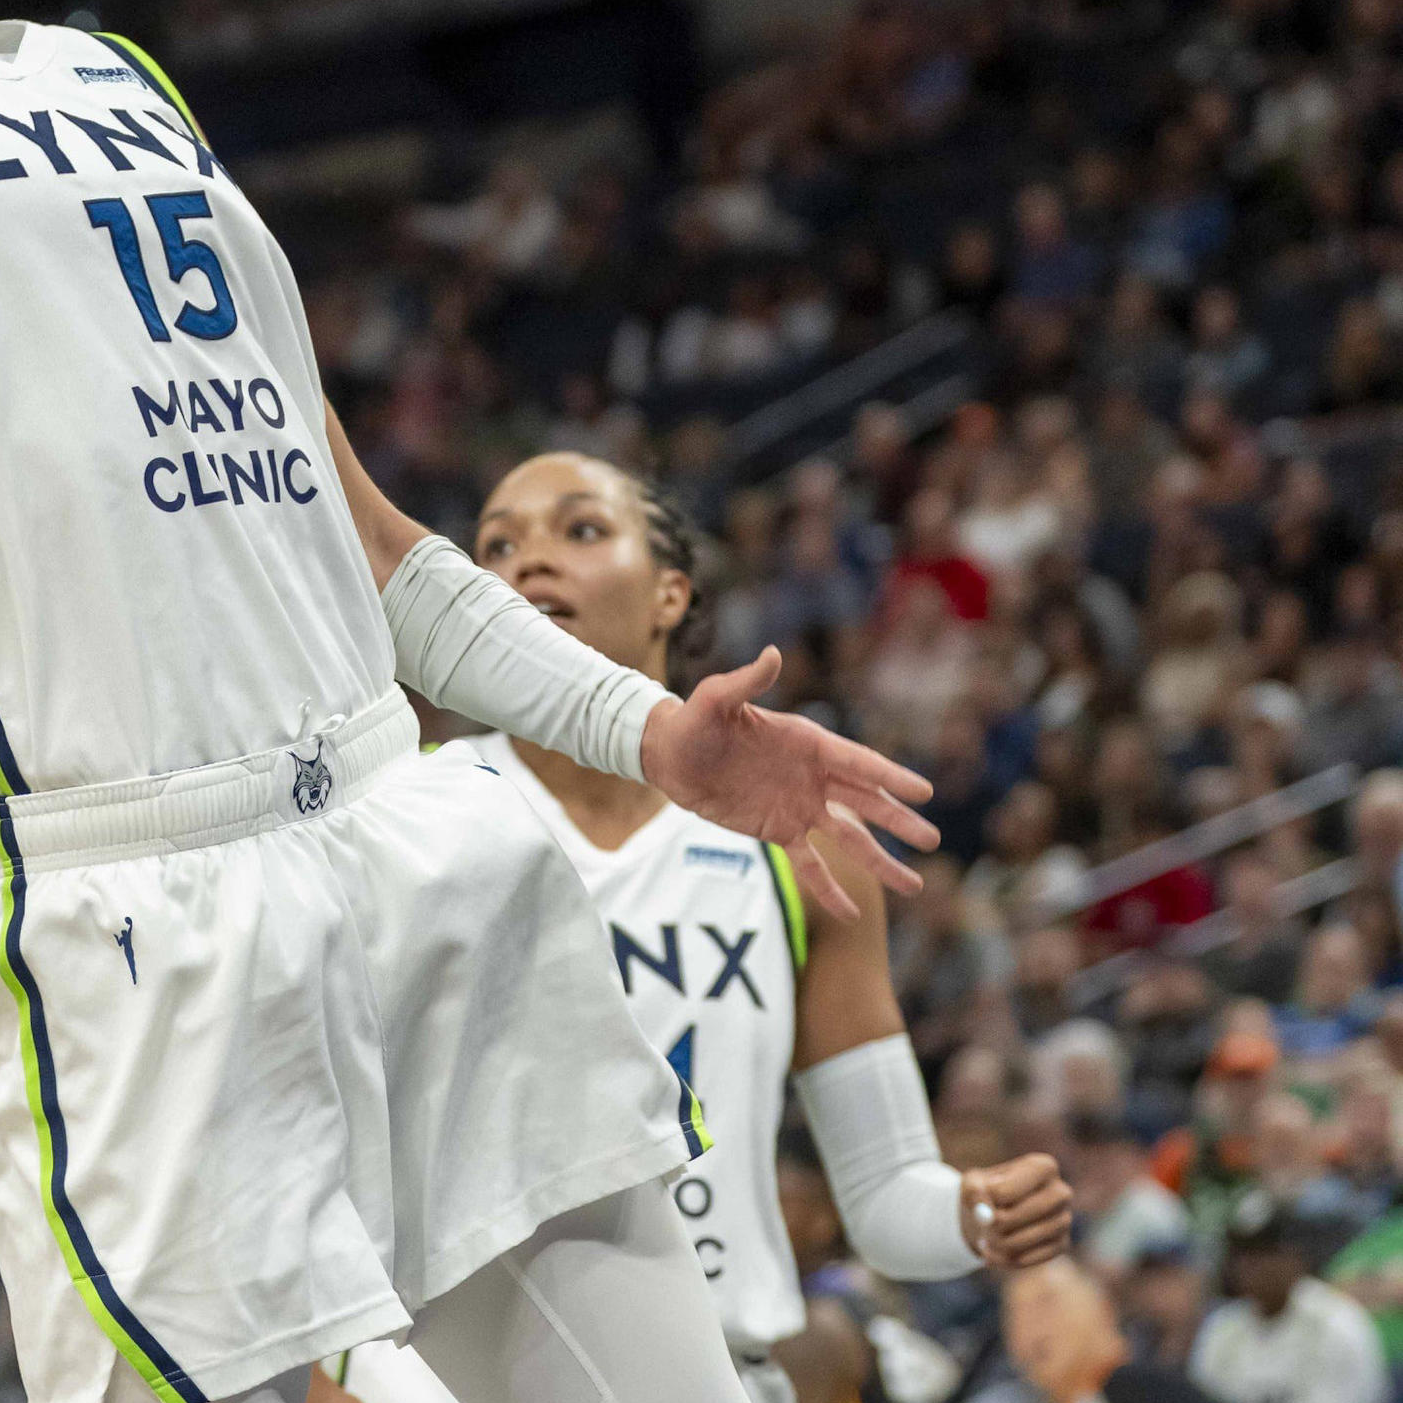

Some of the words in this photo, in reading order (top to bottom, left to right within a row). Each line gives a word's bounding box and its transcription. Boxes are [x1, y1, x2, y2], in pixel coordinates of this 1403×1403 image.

[83, 190, 238, 343] 15
[131, 377, 286, 438] MAYO
[610, 920, 766, 1011] NX
